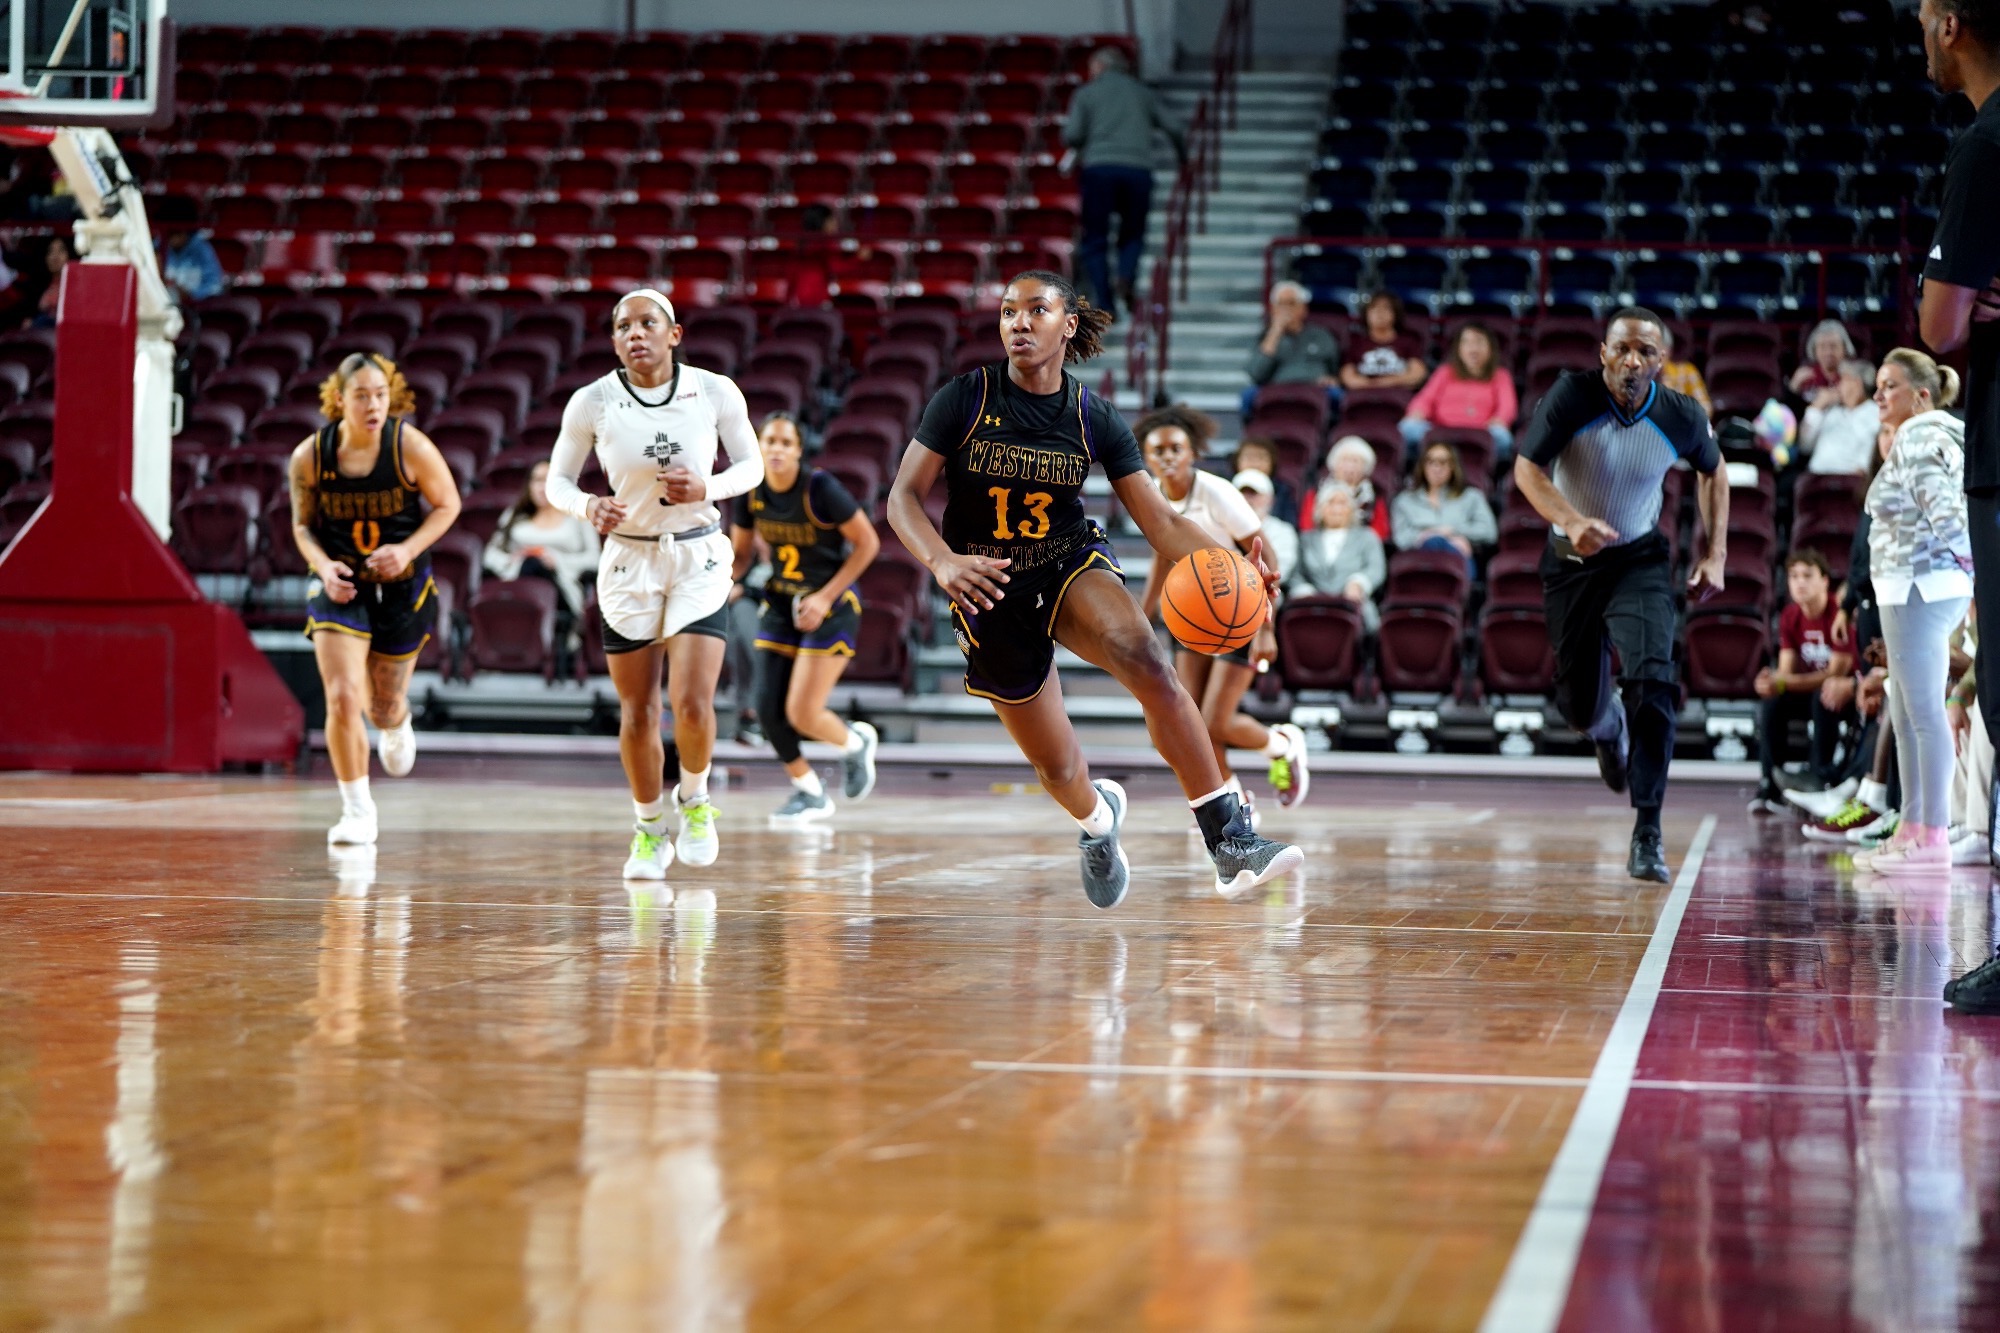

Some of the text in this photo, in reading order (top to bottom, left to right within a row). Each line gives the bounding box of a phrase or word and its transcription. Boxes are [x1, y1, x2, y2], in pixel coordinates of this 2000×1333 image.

[968, 439, 1084, 485] WESTERN
[988, 486, 1053, 540] 13
[351, 520, 381, 556] 0
[777, 544, 804, 581] 2
